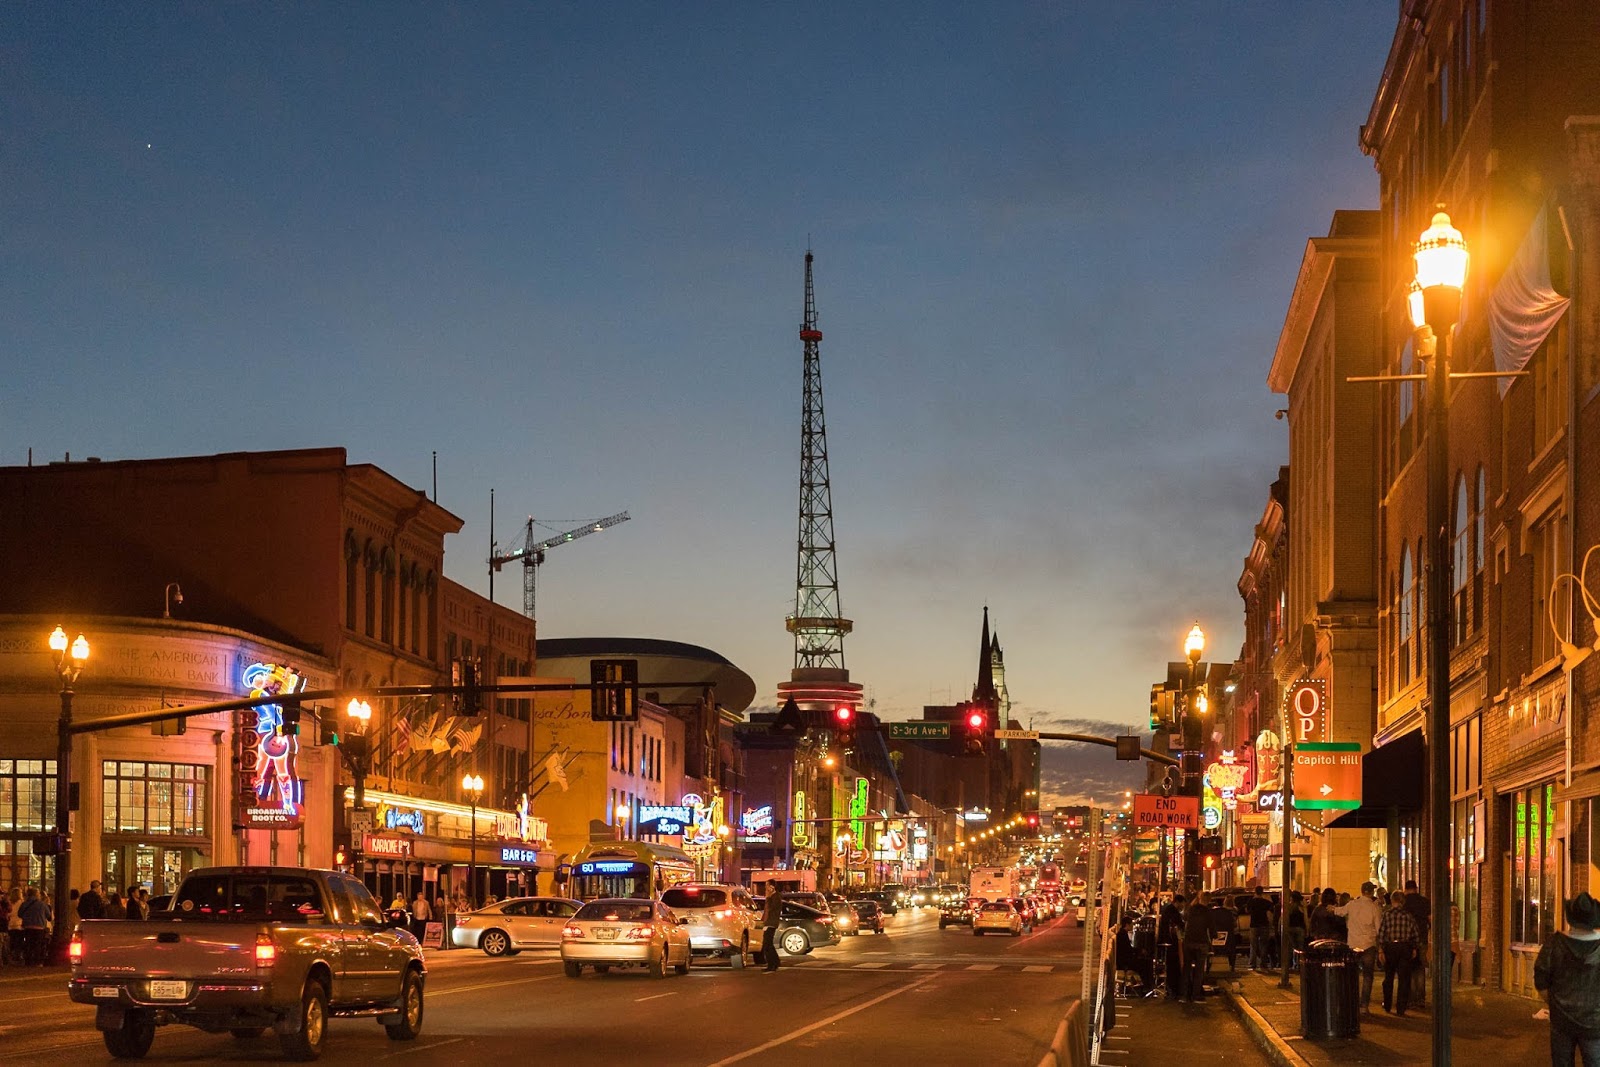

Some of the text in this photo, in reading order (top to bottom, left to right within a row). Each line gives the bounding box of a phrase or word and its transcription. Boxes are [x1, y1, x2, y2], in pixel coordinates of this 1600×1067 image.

[149, 650, 218, 666] AMERICAN
[107, 665, 219, 682] NATIONAL BANK
[892, 725, 948, 736] S-3rd Ave-N
[1003, 730, 1031, 738] PARKING
[1297, 755, 1359, 767] Capitol Hill
[1156, 798, 1177, 811] END
[1140, 812, 1192, 825] ROAD WORK
[371, 838, 398, 854] KARAOKE
[398, 840, 410, 855] BAR
[502, 847, 520, 861] BAR
[520, 849, 526, 862] &
[581, 863, 594, 873] 60
